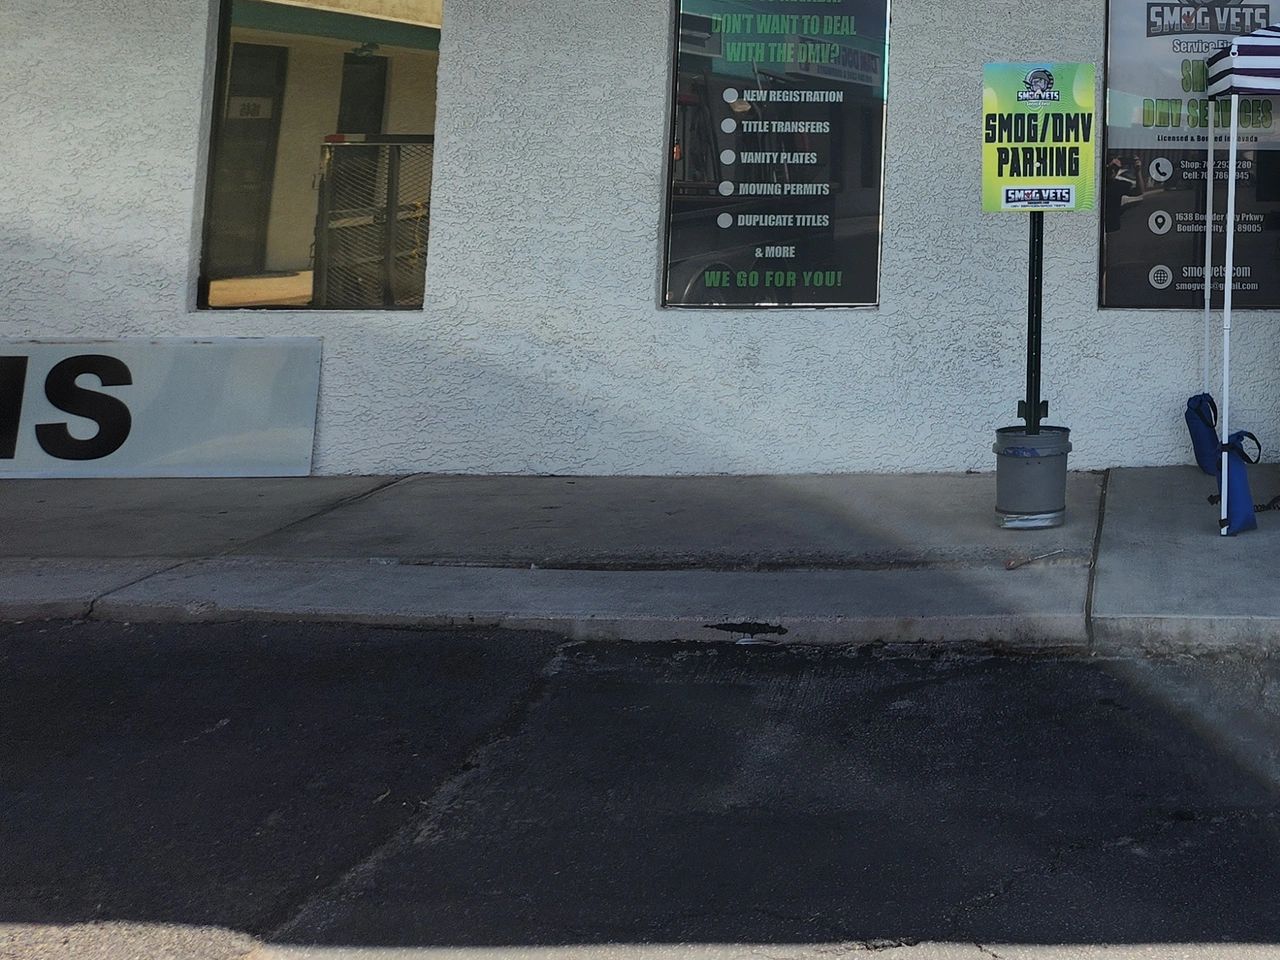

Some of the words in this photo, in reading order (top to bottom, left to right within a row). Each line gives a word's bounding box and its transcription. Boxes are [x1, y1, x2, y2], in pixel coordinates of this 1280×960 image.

[712, 14, 754, 35] DON'T
[757, 14, 800, 35] WANT
[802, 15, 820, 35] TO
[823, 16, 856, 36] DEAL
[1150, 6, 1210, 33] SMOG
[1215, 7, 1267, 33] VETS
[1173, 38, 1216, 53] Service
[726, 42, 767, 63] WITH
[769, 43, 794, 63] THE
[797, 43, 840, 64] DMV?
[743, 90, 768, 102] NEW
[769, 91, 844, 103] REGISTRATION
[1040, 92, 1059, 101] VETS
[1142, 99, 1182, 128] DMV
[741, 121, 770, 133] TITLE
[771, 121, 830, 133] TRANSFERS
[984, 113, 1092, 143] SMOG/DMV
[740, 152, 777, 164] VANITY
[780, 152, 817, 164] PLATES
[997, 147, 1080, 177] PARKING
[1180, 160, 1201, 170] Shop:
[1182, 171, 1200, 180] Cell:
[738, 183, 781, 195] MOVING
[783, 183, 830, 195] PERMITS
[1007, 190, 1039, 202] SMOG
[1041, 190, 1069, 201] VETS
[737, 215, 794, 227] DUPLICATE
[796, 215, 829, 227] TITLES
[1175, 212, 1193, 221] 1638
[1237, 224, 1262, 233] 89005
[755, 247, 764, 258] &
[765, 246, 796, 258] MORE
[704, 272, 730, 287] WE
[736, 272, 760, 287] GO
[765, 272, 796, 287] FOR
[802, 272, 843, 288] YOU!
